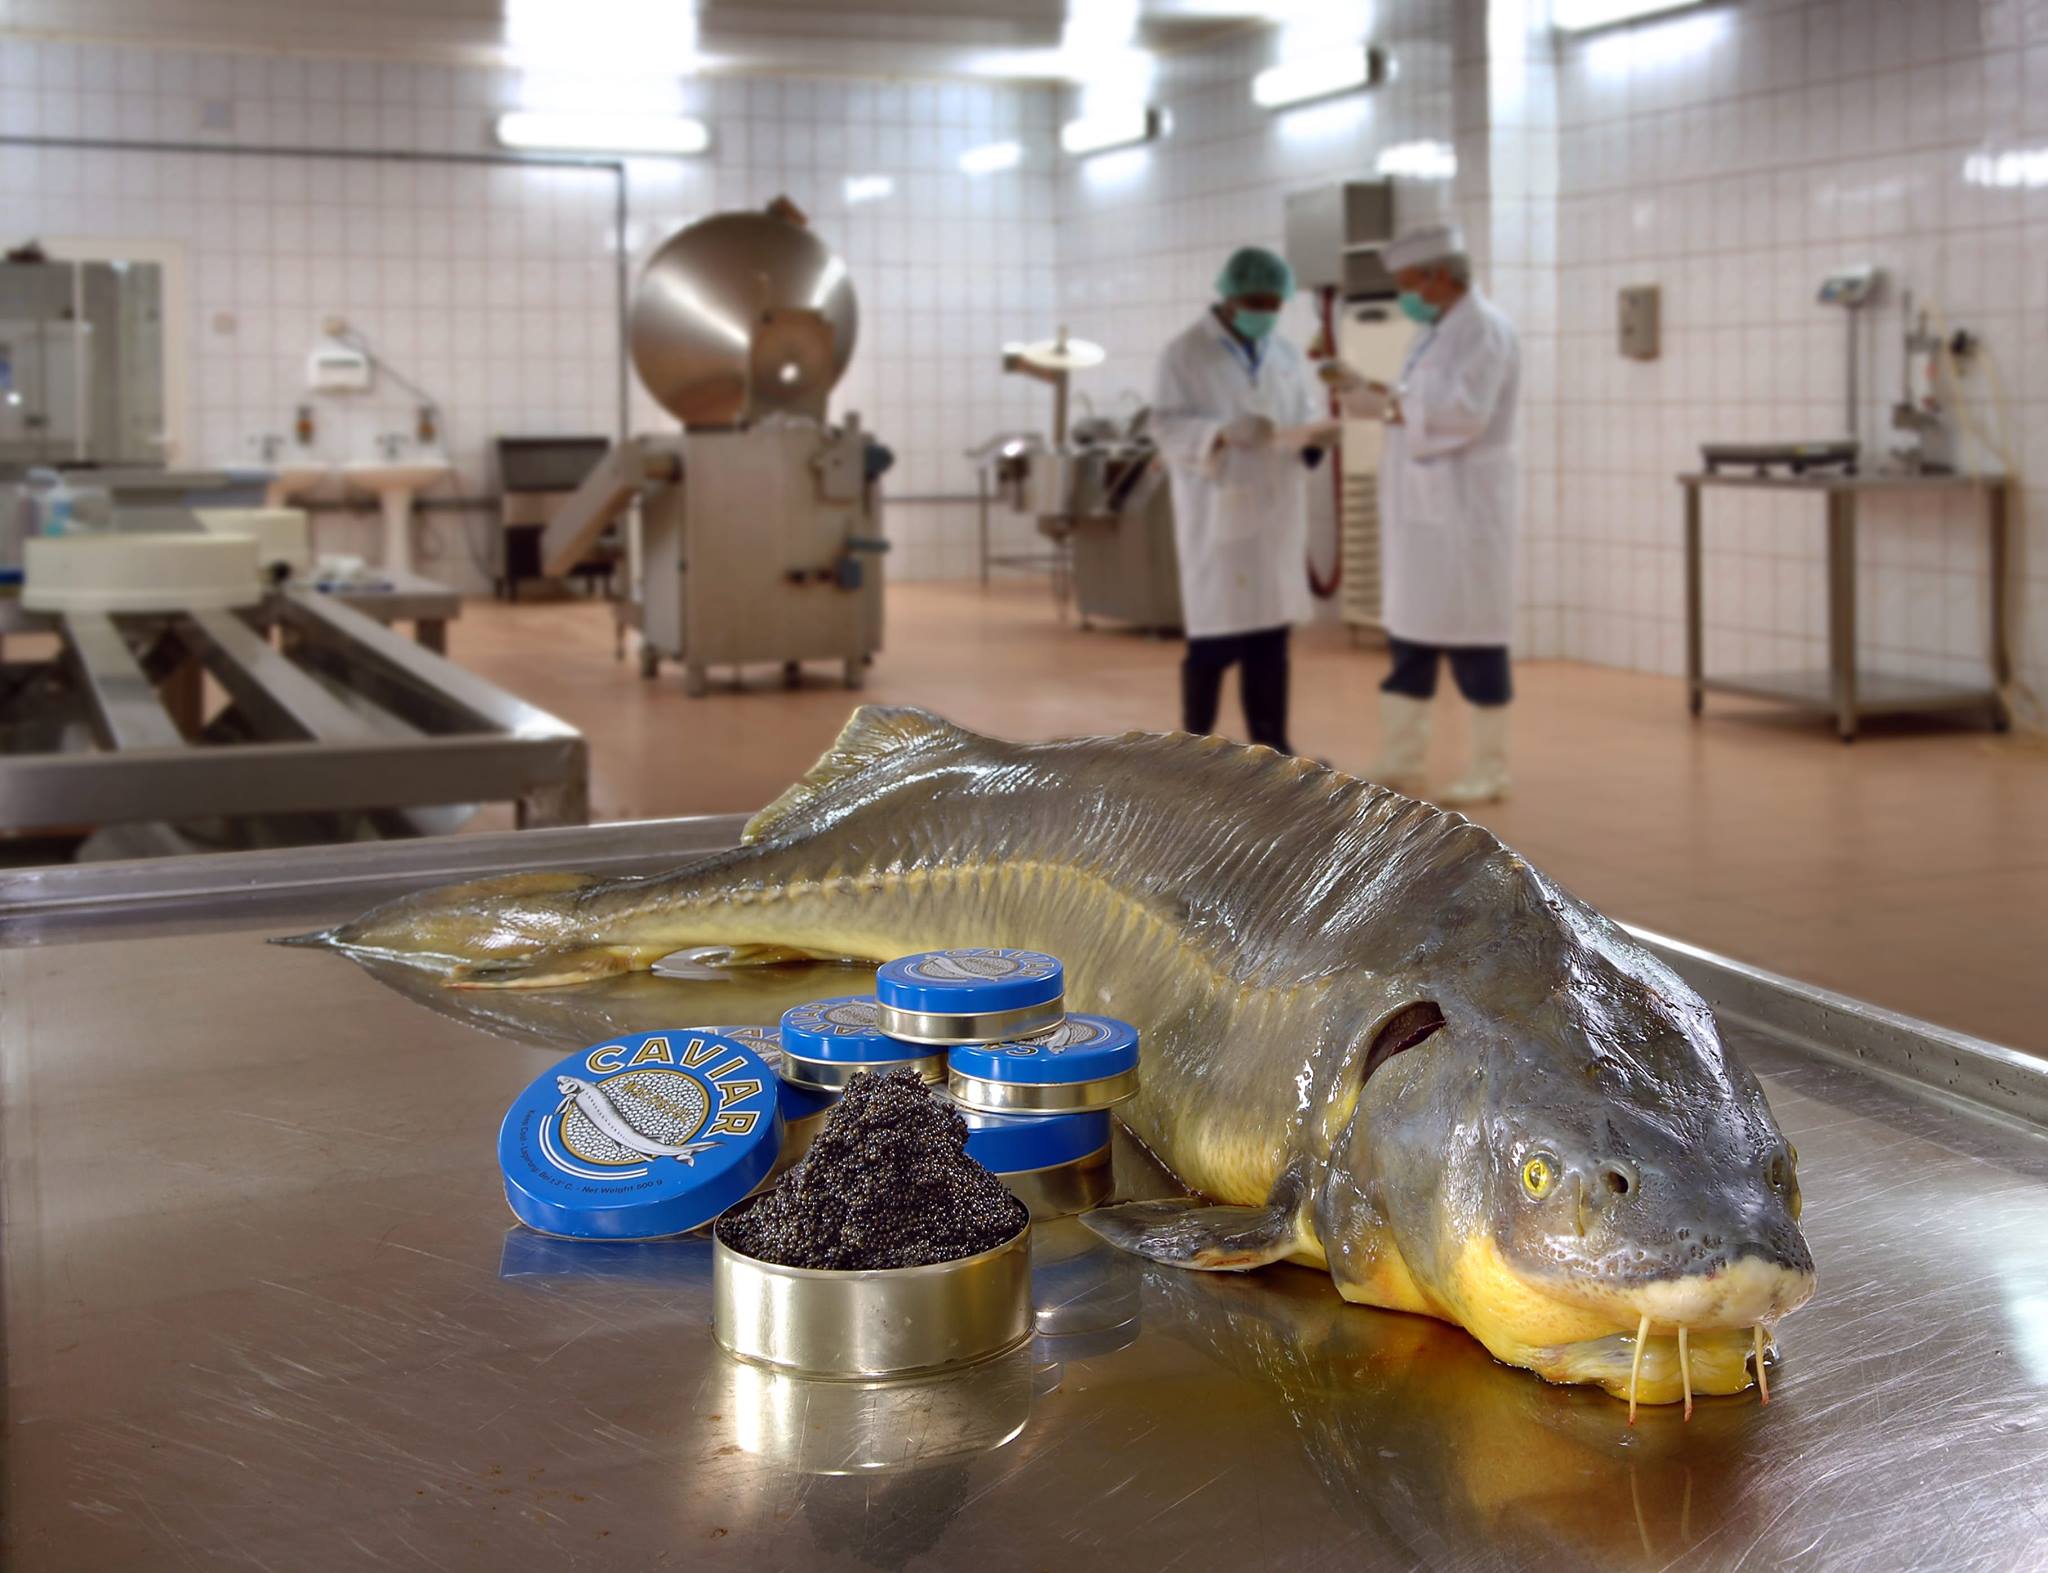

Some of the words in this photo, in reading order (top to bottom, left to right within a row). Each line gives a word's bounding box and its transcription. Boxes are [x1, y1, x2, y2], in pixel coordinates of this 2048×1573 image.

[945, 949, 1056, 977] CAVIAR
[586, 1036, 764, 1138] CAVIAR
[582, 1186, 598, 1194] Net
[599, 1185, 634, 1195] Weight
[636, 1181, 654, 1190] 500
